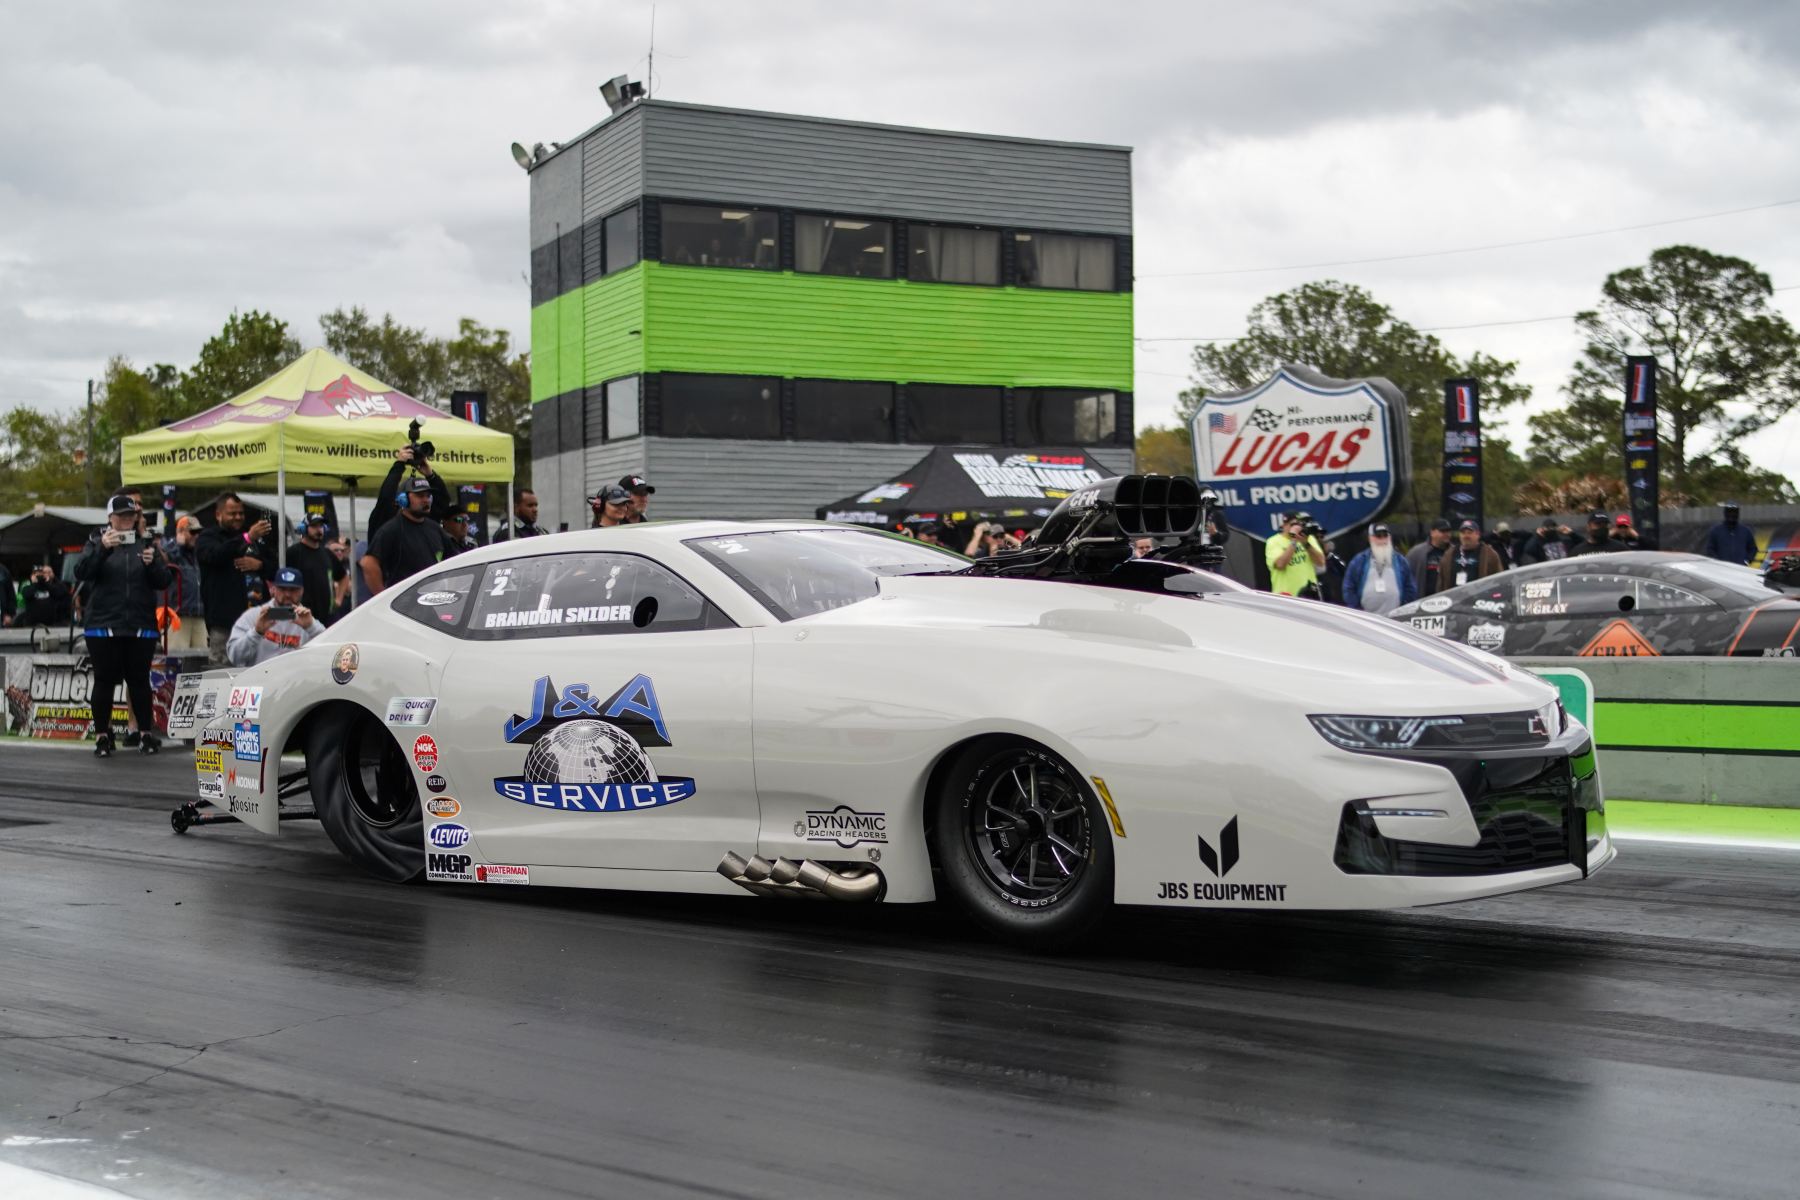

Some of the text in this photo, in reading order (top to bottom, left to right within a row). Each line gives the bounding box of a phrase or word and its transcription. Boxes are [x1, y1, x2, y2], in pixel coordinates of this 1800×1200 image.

[335, 395, 392, 420] WMS
[1287, 412, 1375, 427] PERFORMANCE
[140, 441, 267, 466] www.raceosw.com
[1214, 428, 1371, 476] LUCAS
[1250, 480, 1380, 505] PRODUCTS
[490, 576, 509, 597] 2
[485, 605, 632, 628] BRANDON SNIDER
[173, 695, 198, 715] CFH
[405, 701, 430, 709] QUICK
[504, 673, 672, 746] J&A
[389, 713, 414, 721] DRIVE
[202, 728, 233, 743] DIAMOND
[235, 730, 259, 742] CAMPING
[236, 741, 260, 755] WORLD
[417, 743, 434, 752] NGK
[197, 750, 221, 765] BULLET
[200, 780, 222, 793] Fragola
[504, 782, 688, 810] SERVICE
[808, 815, 886, 831] DYNAMIC
[428, 824, 470, 846] CLEVITE
[808, 830, 887, 839] RACING HEADERS
[428, 853, 472, 874] MGP
[487, 866, 528, 876] WATERMAN
[428, 872, 458, 880] CONNECTING
[1157, 882, 1287, 901] JBS EQUIPMENT
[1001, 892, 1058, 907] FORGED
